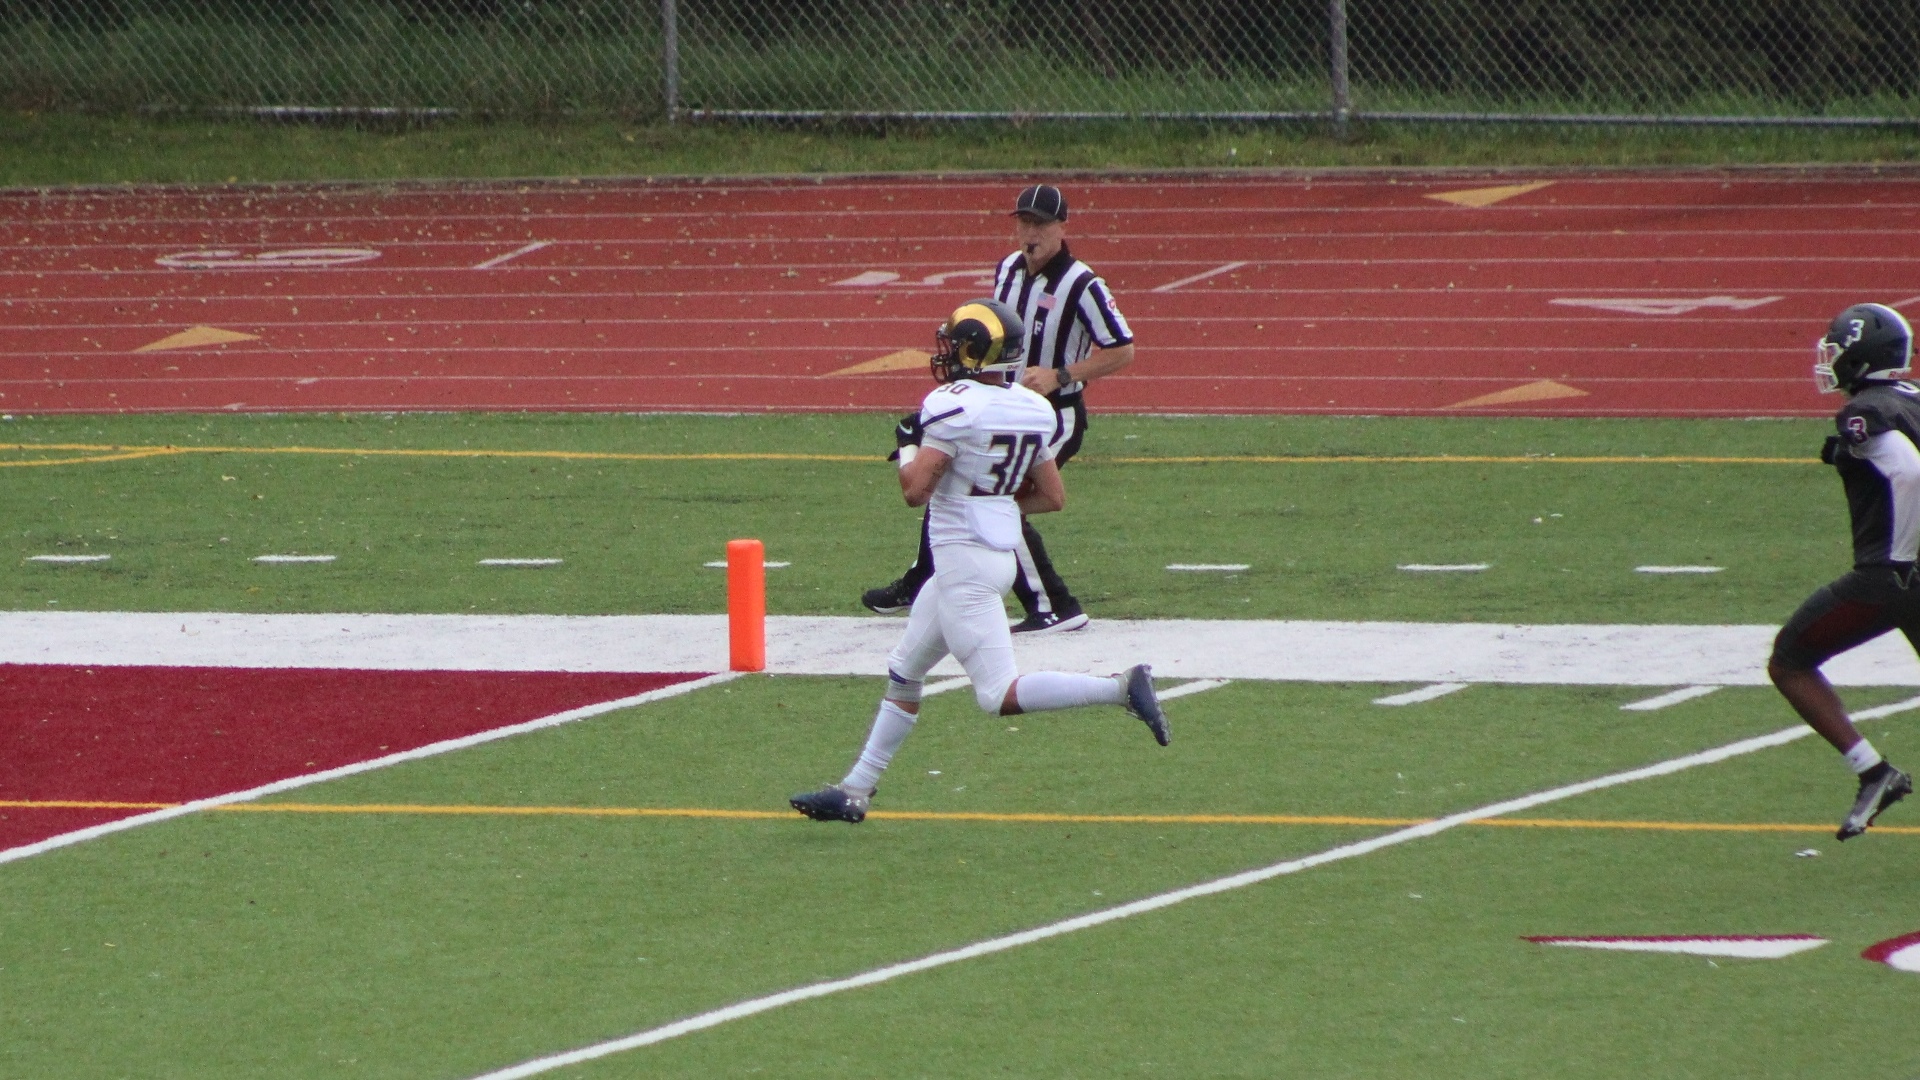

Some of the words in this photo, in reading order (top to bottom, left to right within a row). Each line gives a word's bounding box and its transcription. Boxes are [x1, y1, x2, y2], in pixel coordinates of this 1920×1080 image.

[1844, 319, 1865, 348] 3
[1848, 416, 1869, 444] 3
[970, 433, 1042, 496] 30
